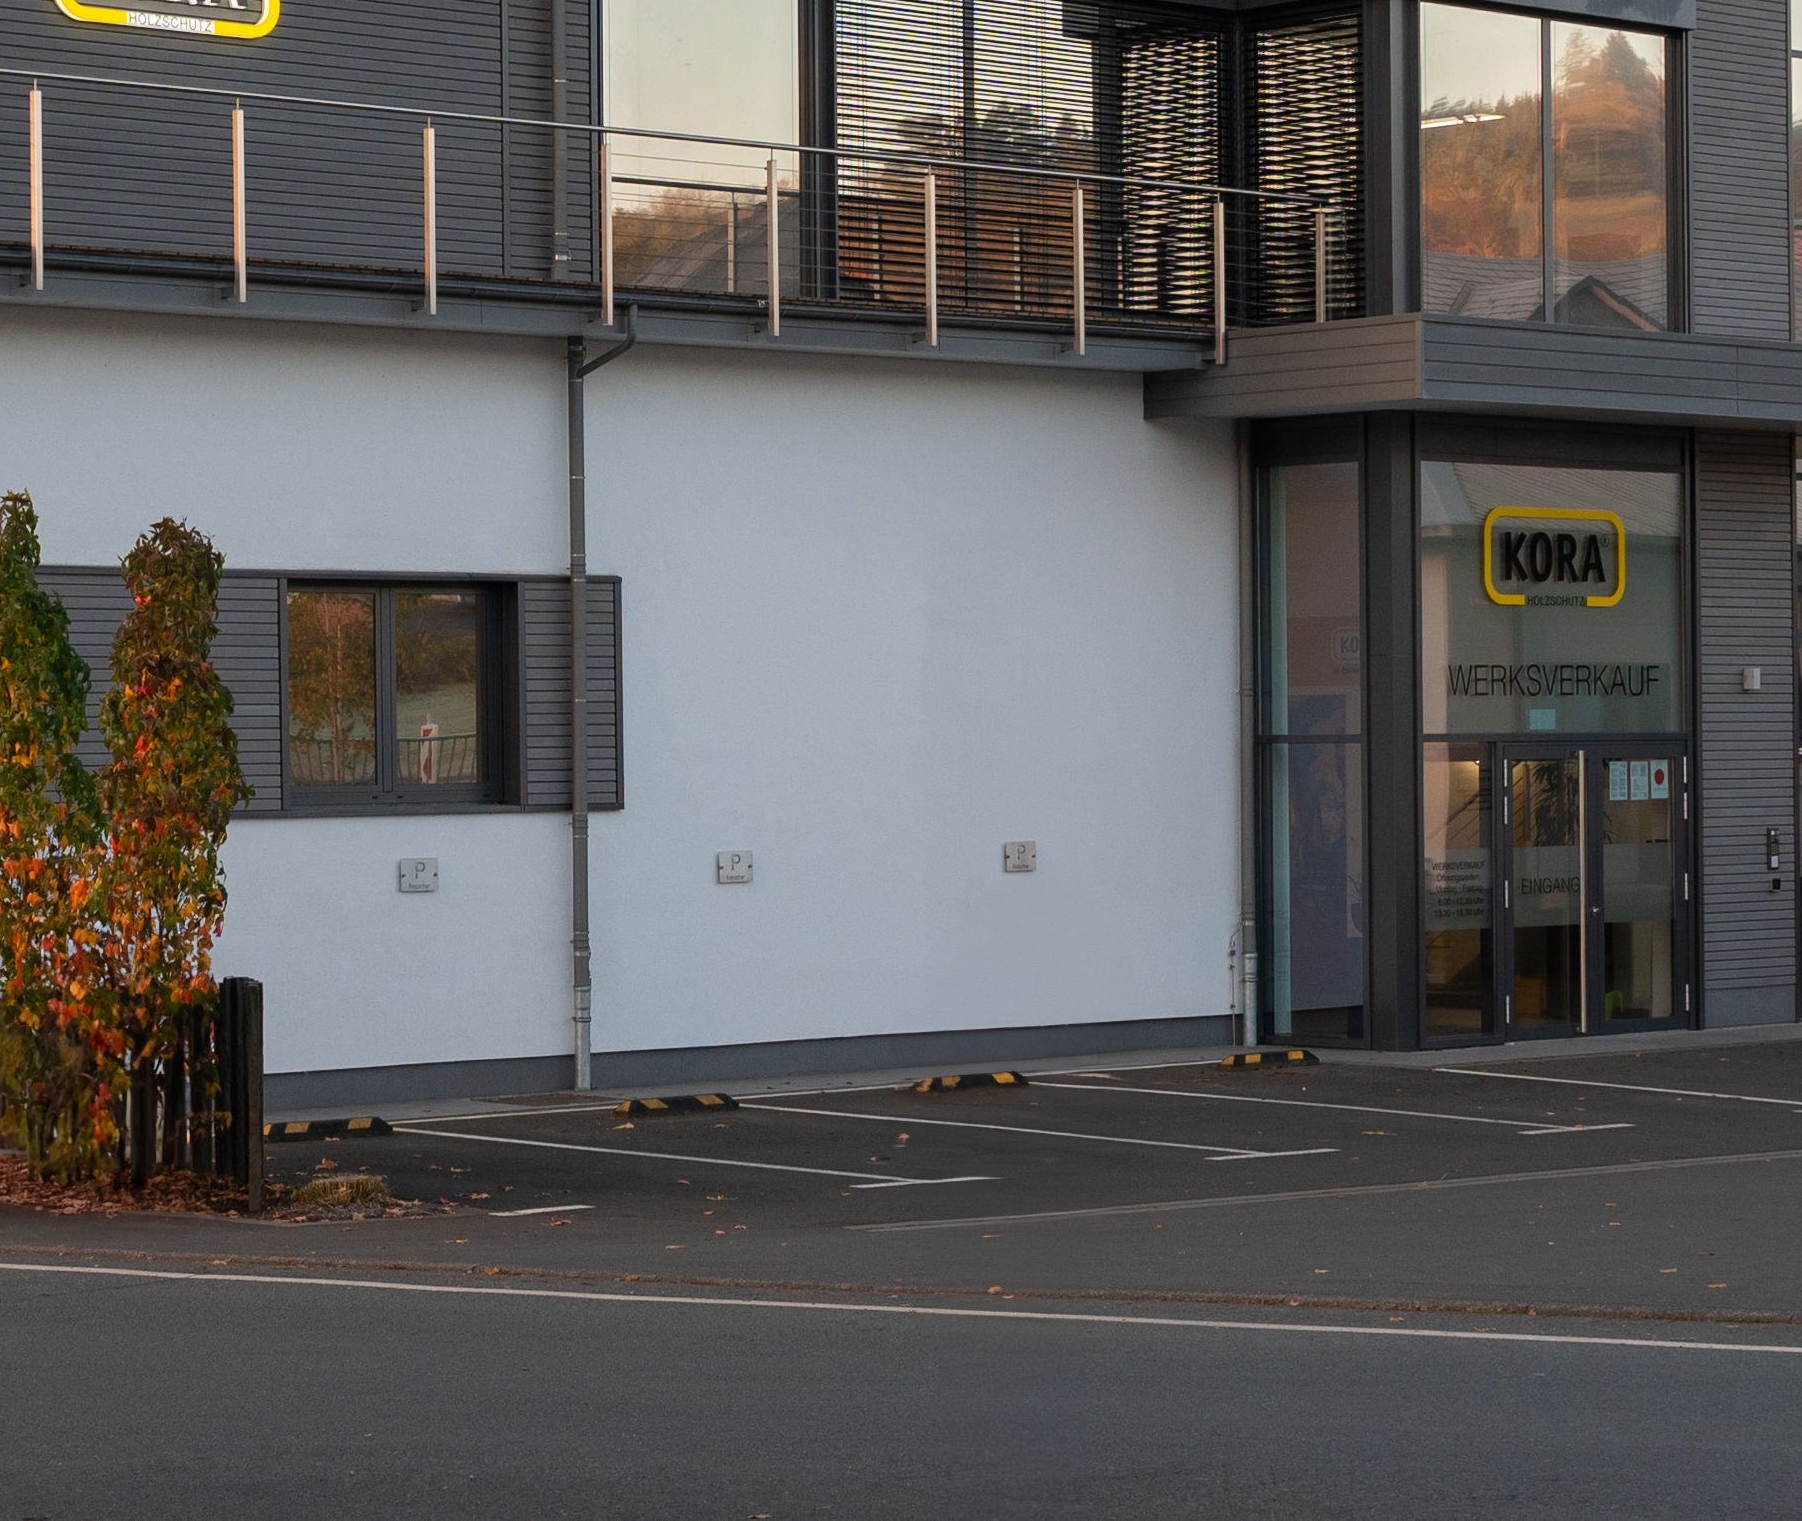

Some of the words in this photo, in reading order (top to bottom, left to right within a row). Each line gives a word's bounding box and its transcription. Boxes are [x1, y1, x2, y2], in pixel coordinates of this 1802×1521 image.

[128, 11, 213, 34] HOLZSCHUTZ
[1526, 595, 1586, 608] HOLZSCHUTZ
[1447, 663, 1661, 697] WERKSVERKAUF
[1521, 876, 1581, 896] EINGANG
